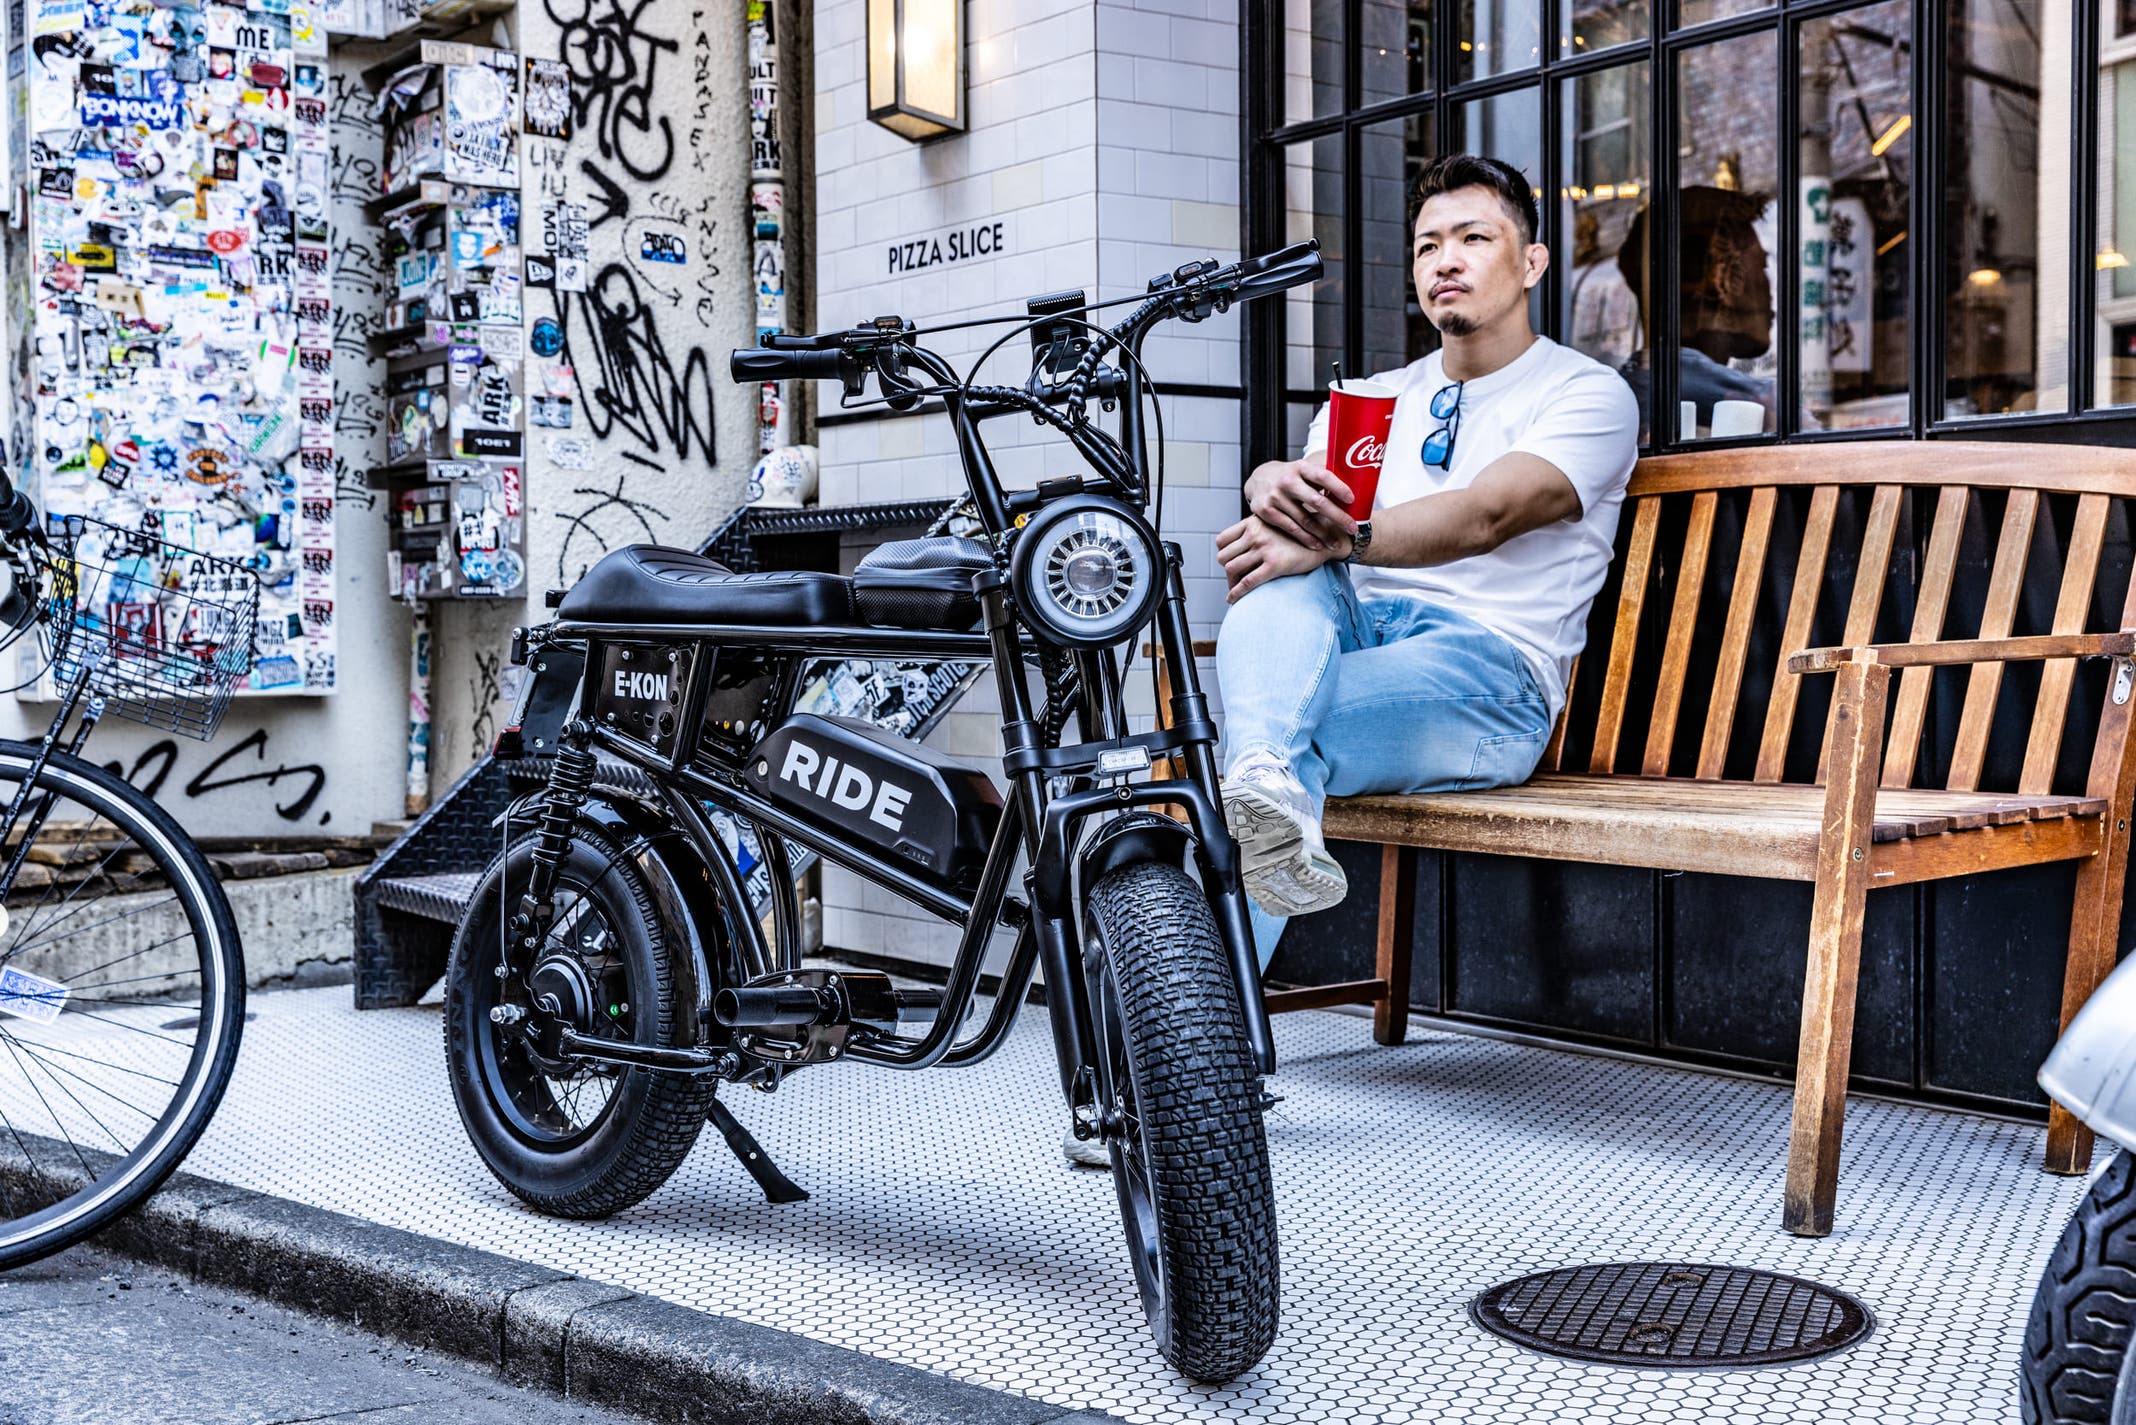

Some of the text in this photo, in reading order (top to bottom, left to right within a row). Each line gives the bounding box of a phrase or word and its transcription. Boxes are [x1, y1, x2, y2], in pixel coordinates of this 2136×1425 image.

[888, 222, 1003, 274] PIZZA SLICE
[614, 670, 668, 701] E-KON
[779, 740, 912, 832] RIDE
